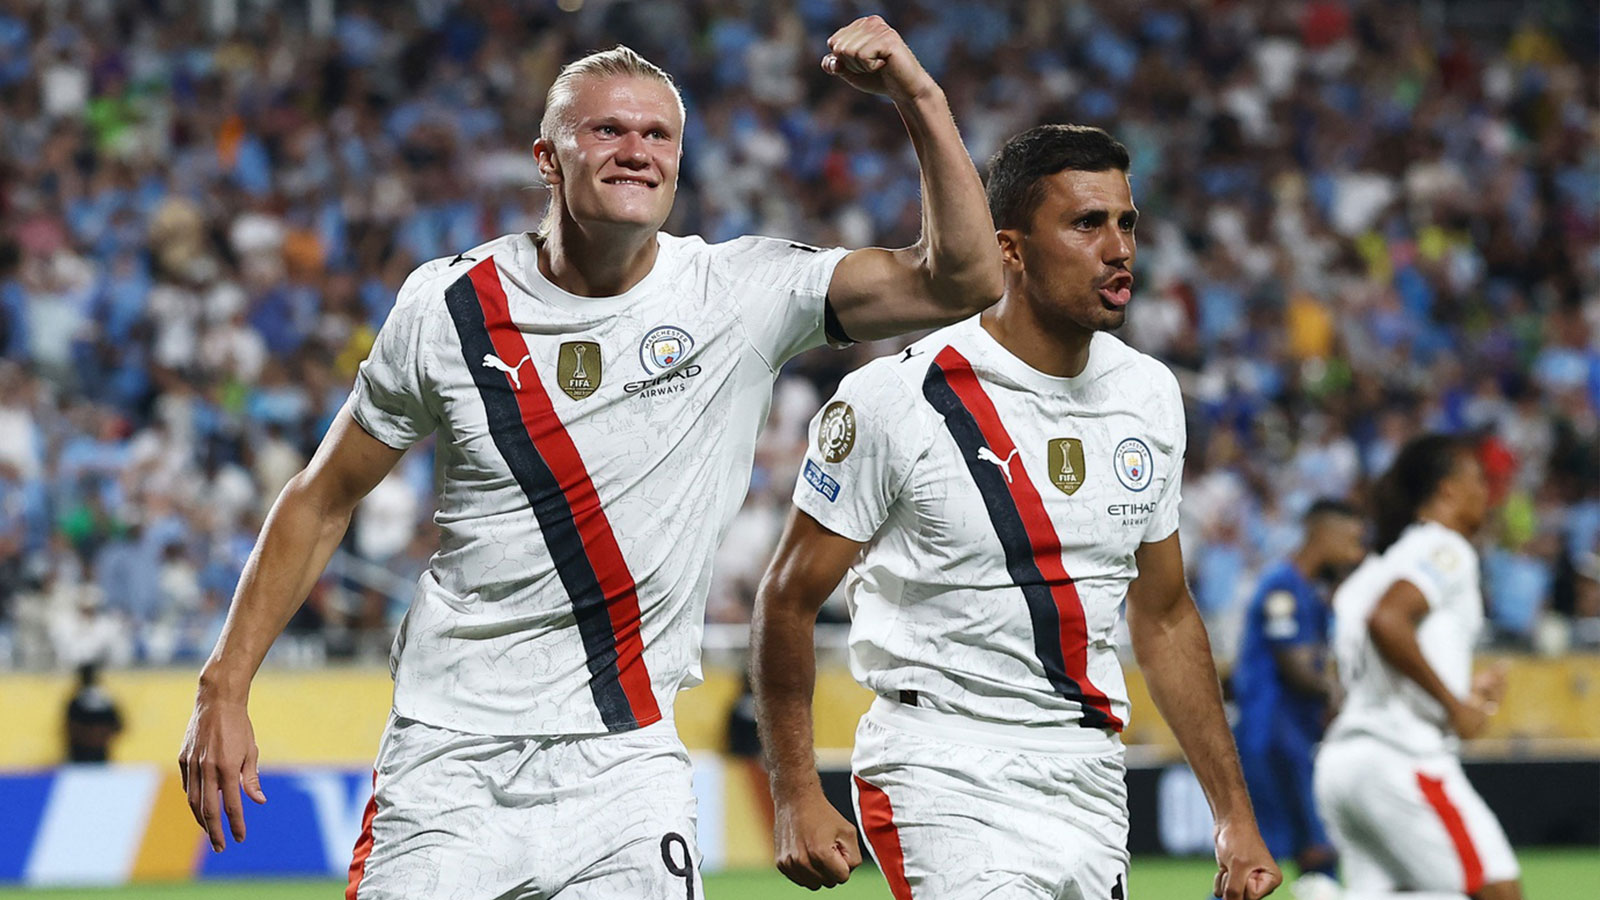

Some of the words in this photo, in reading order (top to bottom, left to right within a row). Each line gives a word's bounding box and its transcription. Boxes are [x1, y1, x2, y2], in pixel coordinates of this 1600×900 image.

[645, 330, 688, 349] MANCHESTER
[623, 365, 702, 393] ETIHAD
[640, 383, 686, 399] AIRWAYS
[1117, 442, 1148, 459] MANCHESTER
[1059, 474, 1077, 482] FIFA
[1107, 502, 1157, 516] ETIHAD
[660, 832, 695, 900] 9
